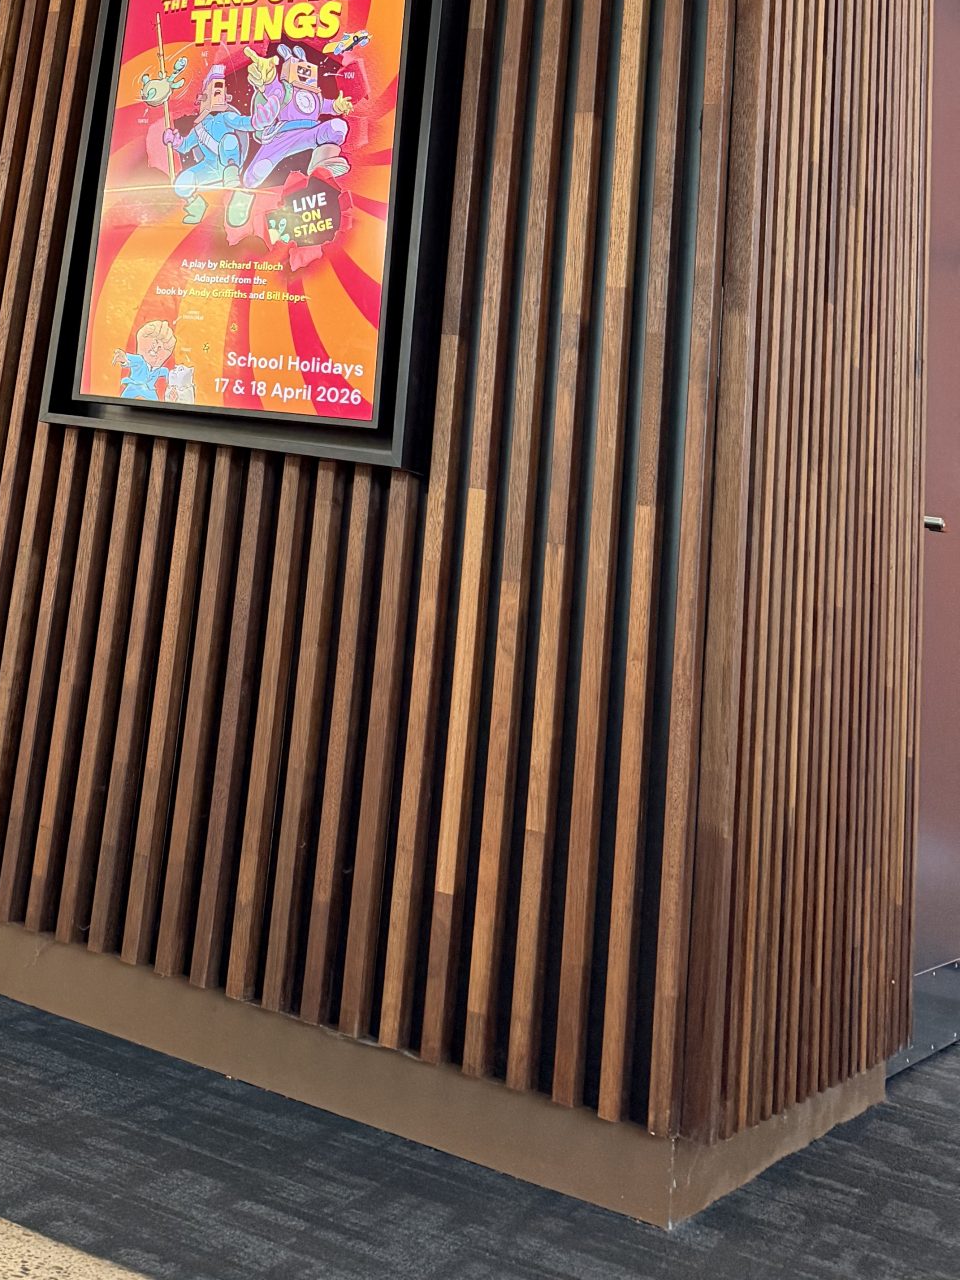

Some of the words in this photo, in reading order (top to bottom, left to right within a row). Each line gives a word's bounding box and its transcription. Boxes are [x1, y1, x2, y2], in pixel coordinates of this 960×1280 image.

[163, 0, 189, 13] THE
[190, 1, 342, 47] THINGS
[343, 72, 355, 80] YOU
[292, 191, 328, 213] LIVE
[301, 208, 322, 223] ON
[293, 218, 333, 238] STAGE
[181, 259, 189, 268] A
[189, 259, 207, 271] play
[207, 259, 218, 270] by
[219, 261, 252, 270] Richard
[253, 262, 284, 272] Tulloch
[194, 273, 230, 285] Adapted
[231, 275, 252, 285] from
[253, 276, 268, 285] the
[156, 286, 176, 296] book
[177, 287, 188, 297] by
[189, 288, 211, 299] Andy
[212, 289, 248, 299] Griffiths
[249, 290, 265, 300] and
[266, 291, 281, 301] Bill
[281, 293, 307, 304] Hope
[227, 351, 284, 371] School
[287, 356, 364, 380] Holidays
[214, 377, 230, 393] 17
[232, 379, 245, 395] &
[250, 381, 267, 397] 18
[270, 382, 312, 403] April
[316, 386, 362, 405] 2026
